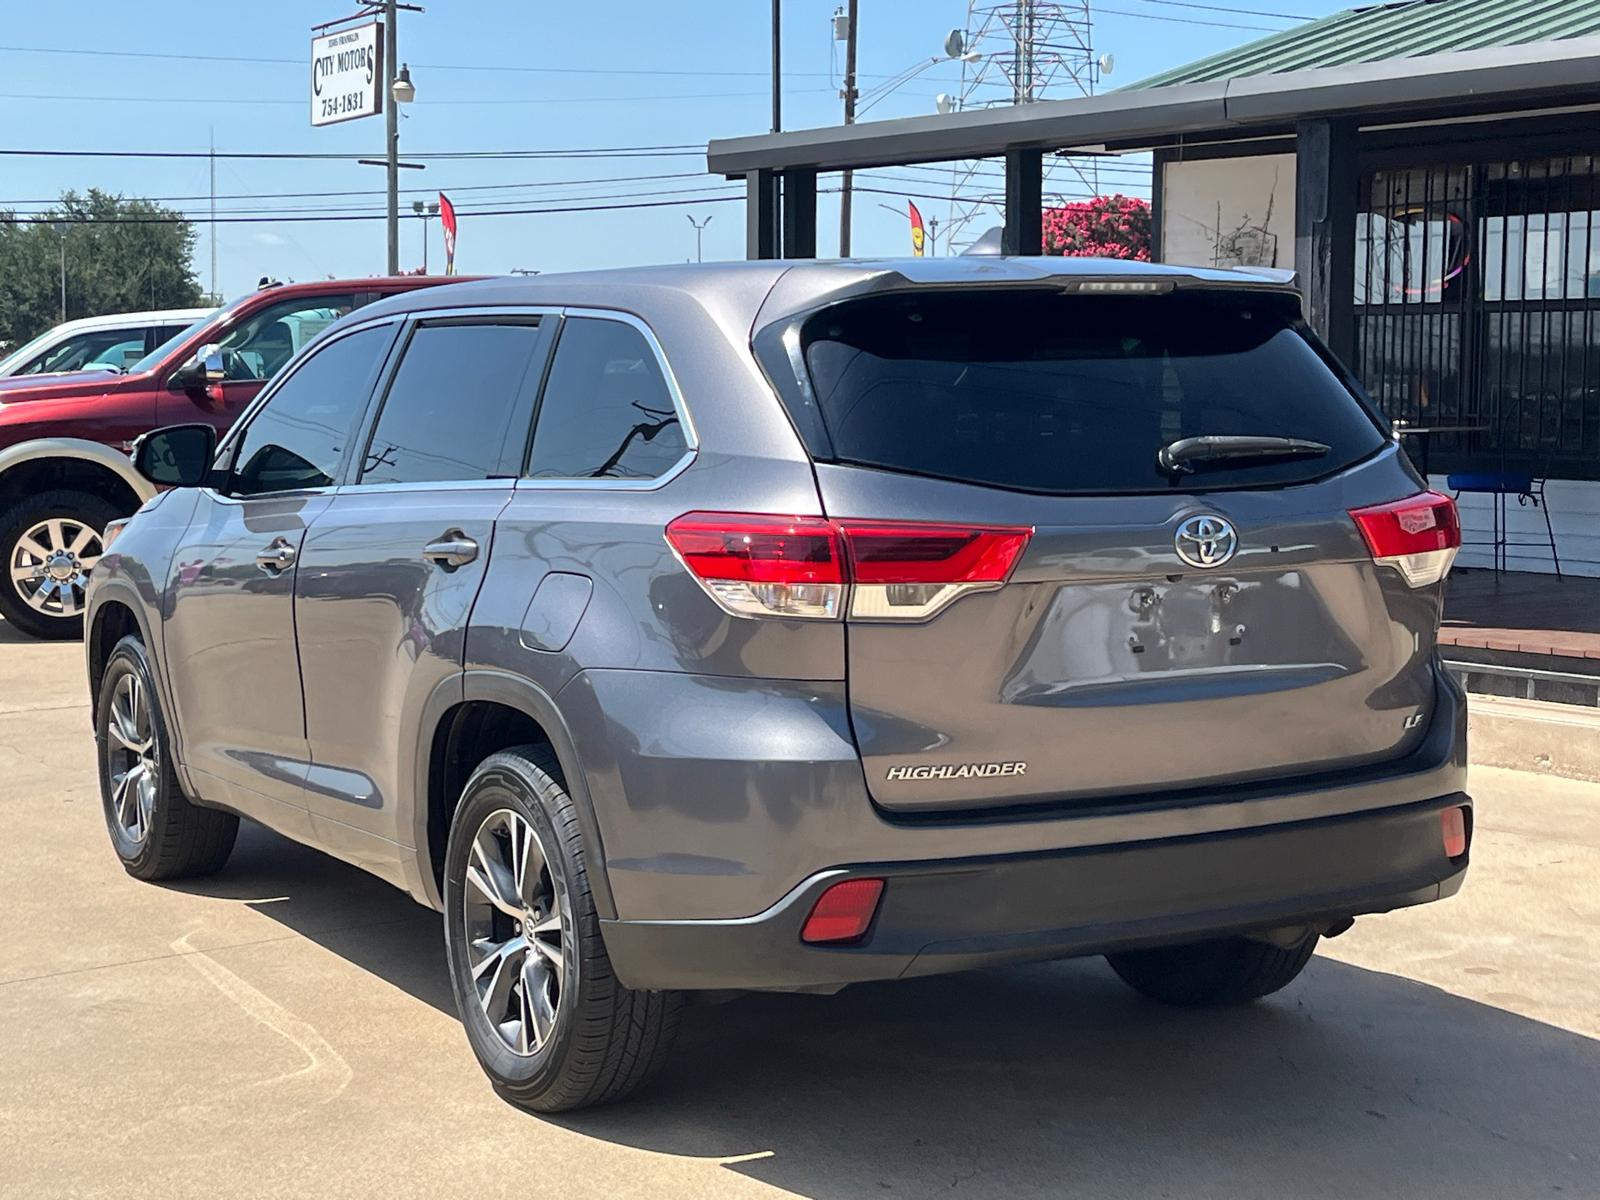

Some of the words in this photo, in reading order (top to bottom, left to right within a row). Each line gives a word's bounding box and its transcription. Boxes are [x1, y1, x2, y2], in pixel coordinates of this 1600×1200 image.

[313, 55, 335, 96] CITY
[337, 44, 373, 85] MOTORS
[321, 91, 363, 117] 754-1831
[886, 762, 1027, 780] HIGHLANDER
